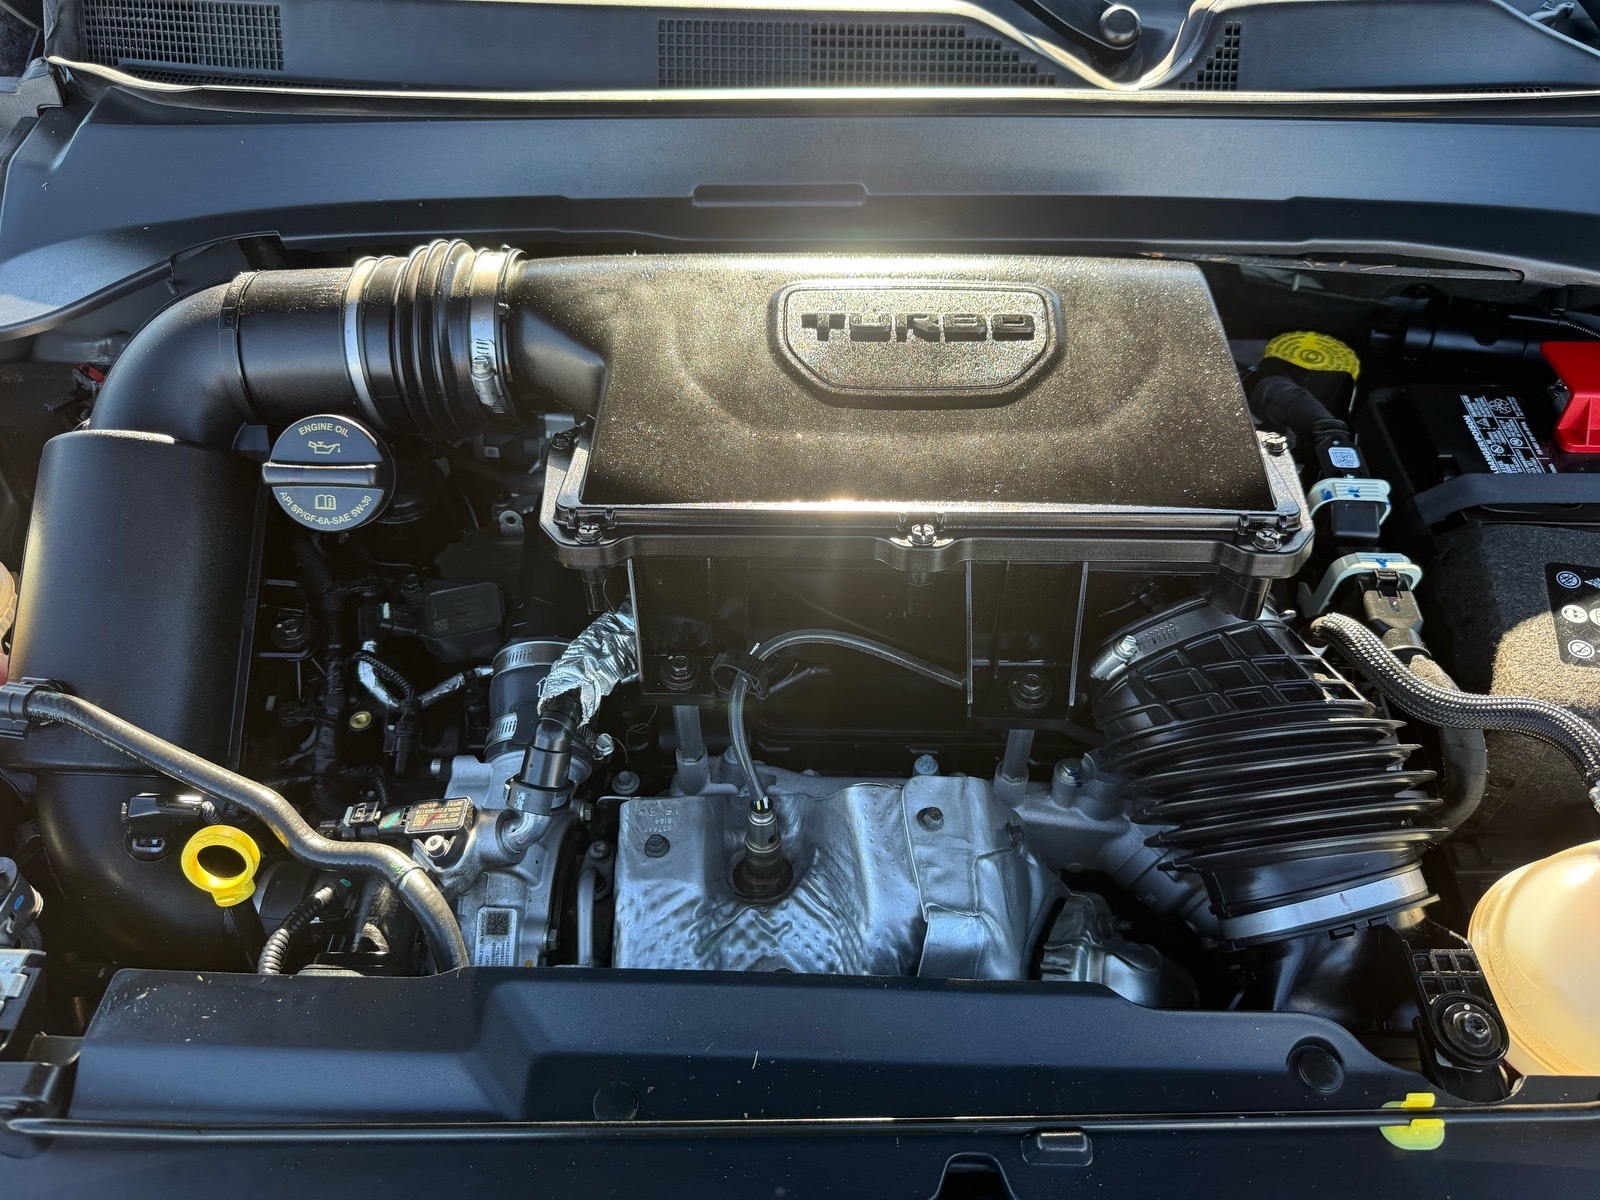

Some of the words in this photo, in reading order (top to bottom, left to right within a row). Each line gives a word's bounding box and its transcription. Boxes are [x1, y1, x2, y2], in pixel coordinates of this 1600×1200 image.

[800, 312, 1036, 342] TURBO
[298, 422, 334, 436] ENGINE
[335, 426, 349, 438] OIL
[279, 491, 294, 507] API
[350, 495, 372, 518] 5W-30
